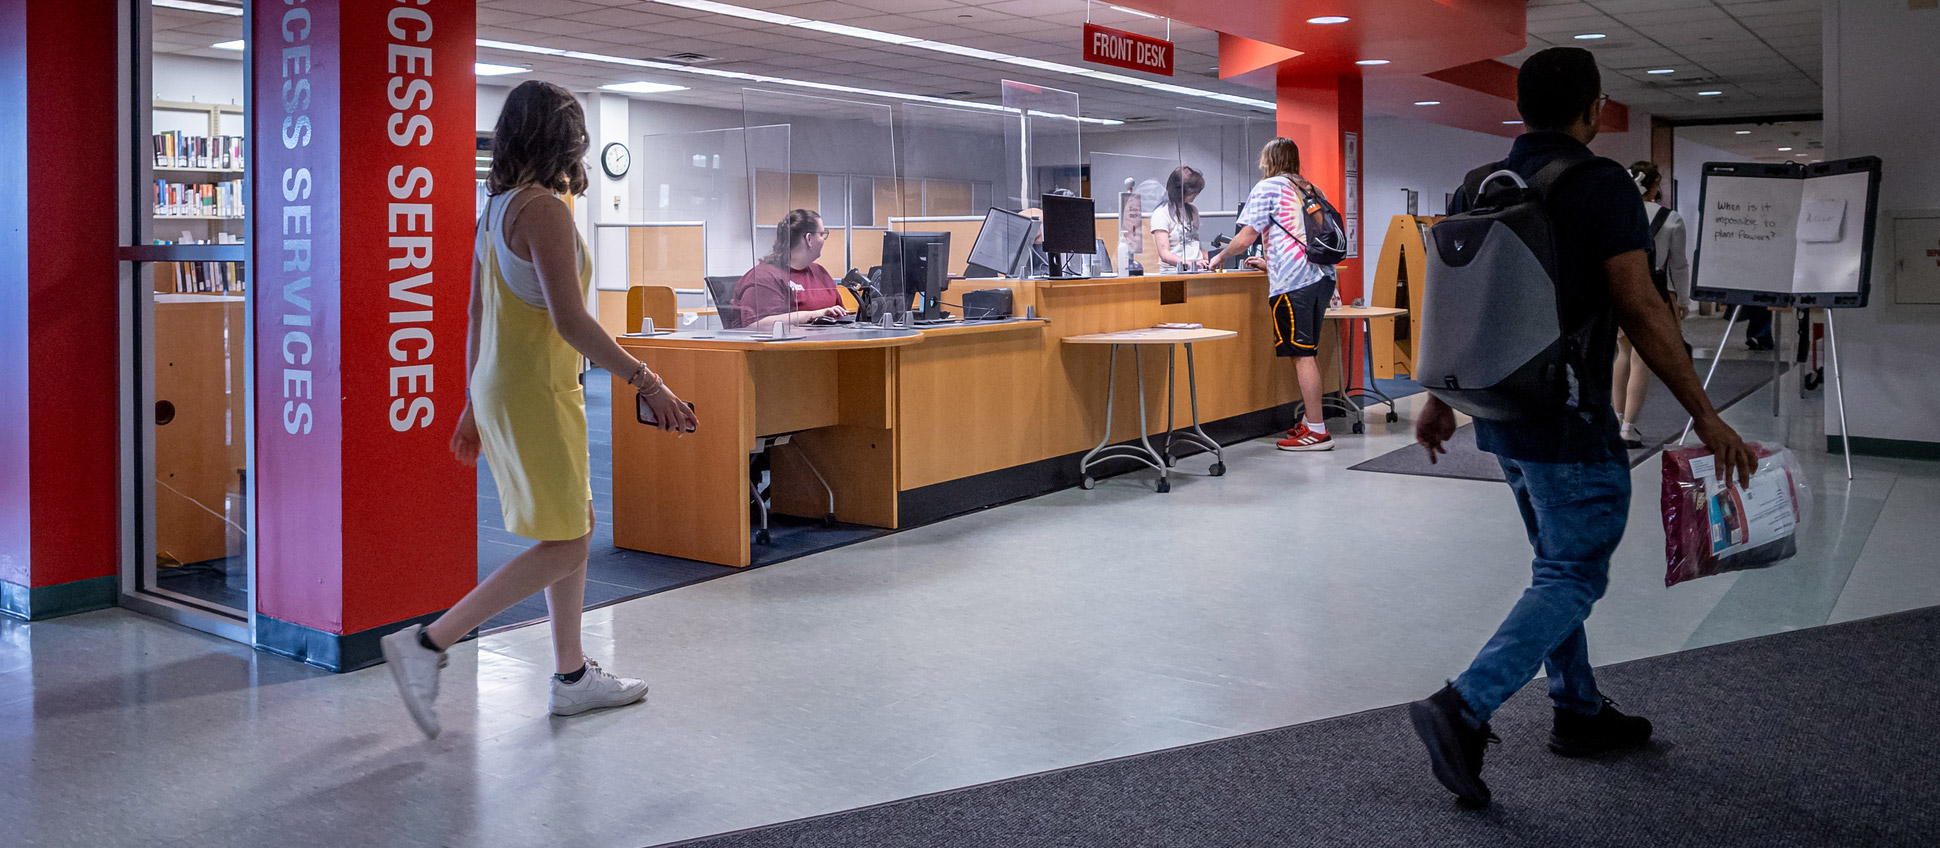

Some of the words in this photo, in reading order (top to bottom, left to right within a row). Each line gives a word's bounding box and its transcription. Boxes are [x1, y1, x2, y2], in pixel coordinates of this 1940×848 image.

[282, 0, 312, 149] CESS
[387, 0, 434, 147] CESS
[1093, 32, 1133, 61] FRONT
[1136, 41, 1166, 68] DESK
[1714, 229, 1735, 241] plant
[1715, 214, 1758, 227] impossible
[1763, 219, 1776, 228] to
[1717, 200, 1741, 211] When
[1747, 202, 1758, 212] is
[1761, 202, 1773, 212] it
[282, 167, 313, 435] SERVICES
[387, 165, 435, 432] SERVICES
